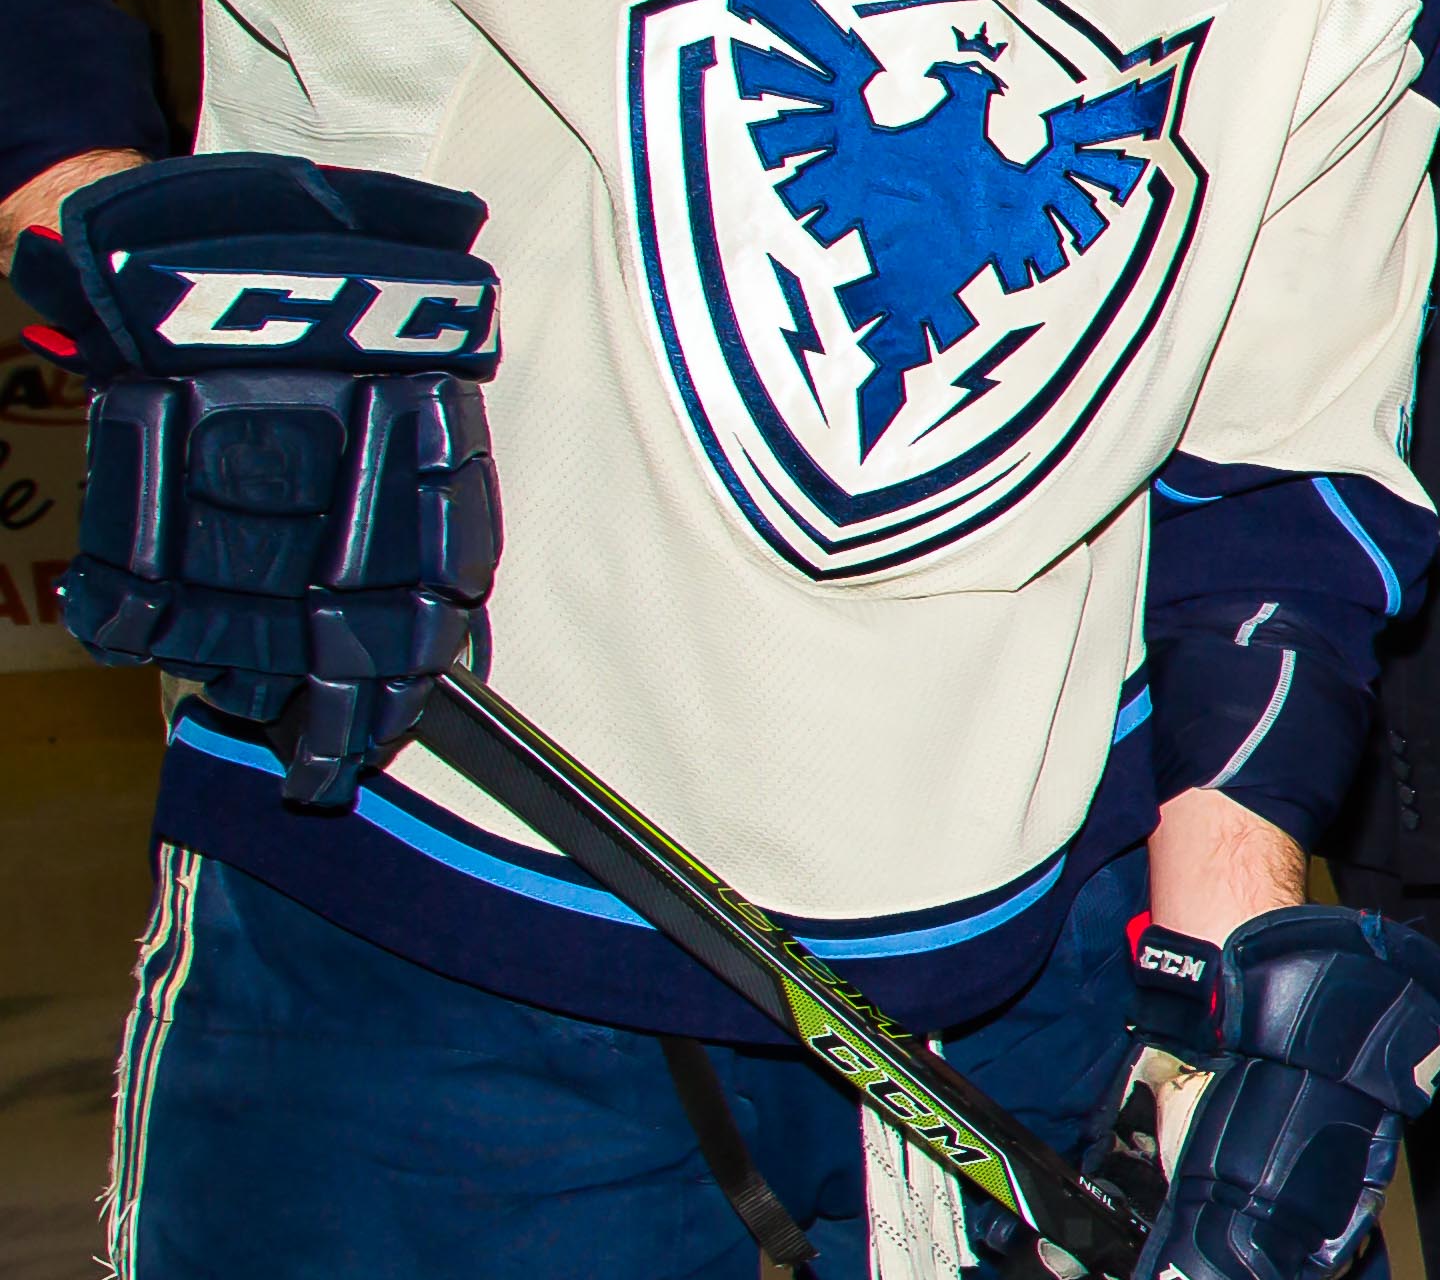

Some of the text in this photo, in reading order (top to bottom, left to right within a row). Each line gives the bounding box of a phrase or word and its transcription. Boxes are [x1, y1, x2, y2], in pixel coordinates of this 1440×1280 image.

[152, 267, 500, 355] CC
[1137, 945, 1207, 984] CCM
[808, 1022, 990, 1165] CCM
